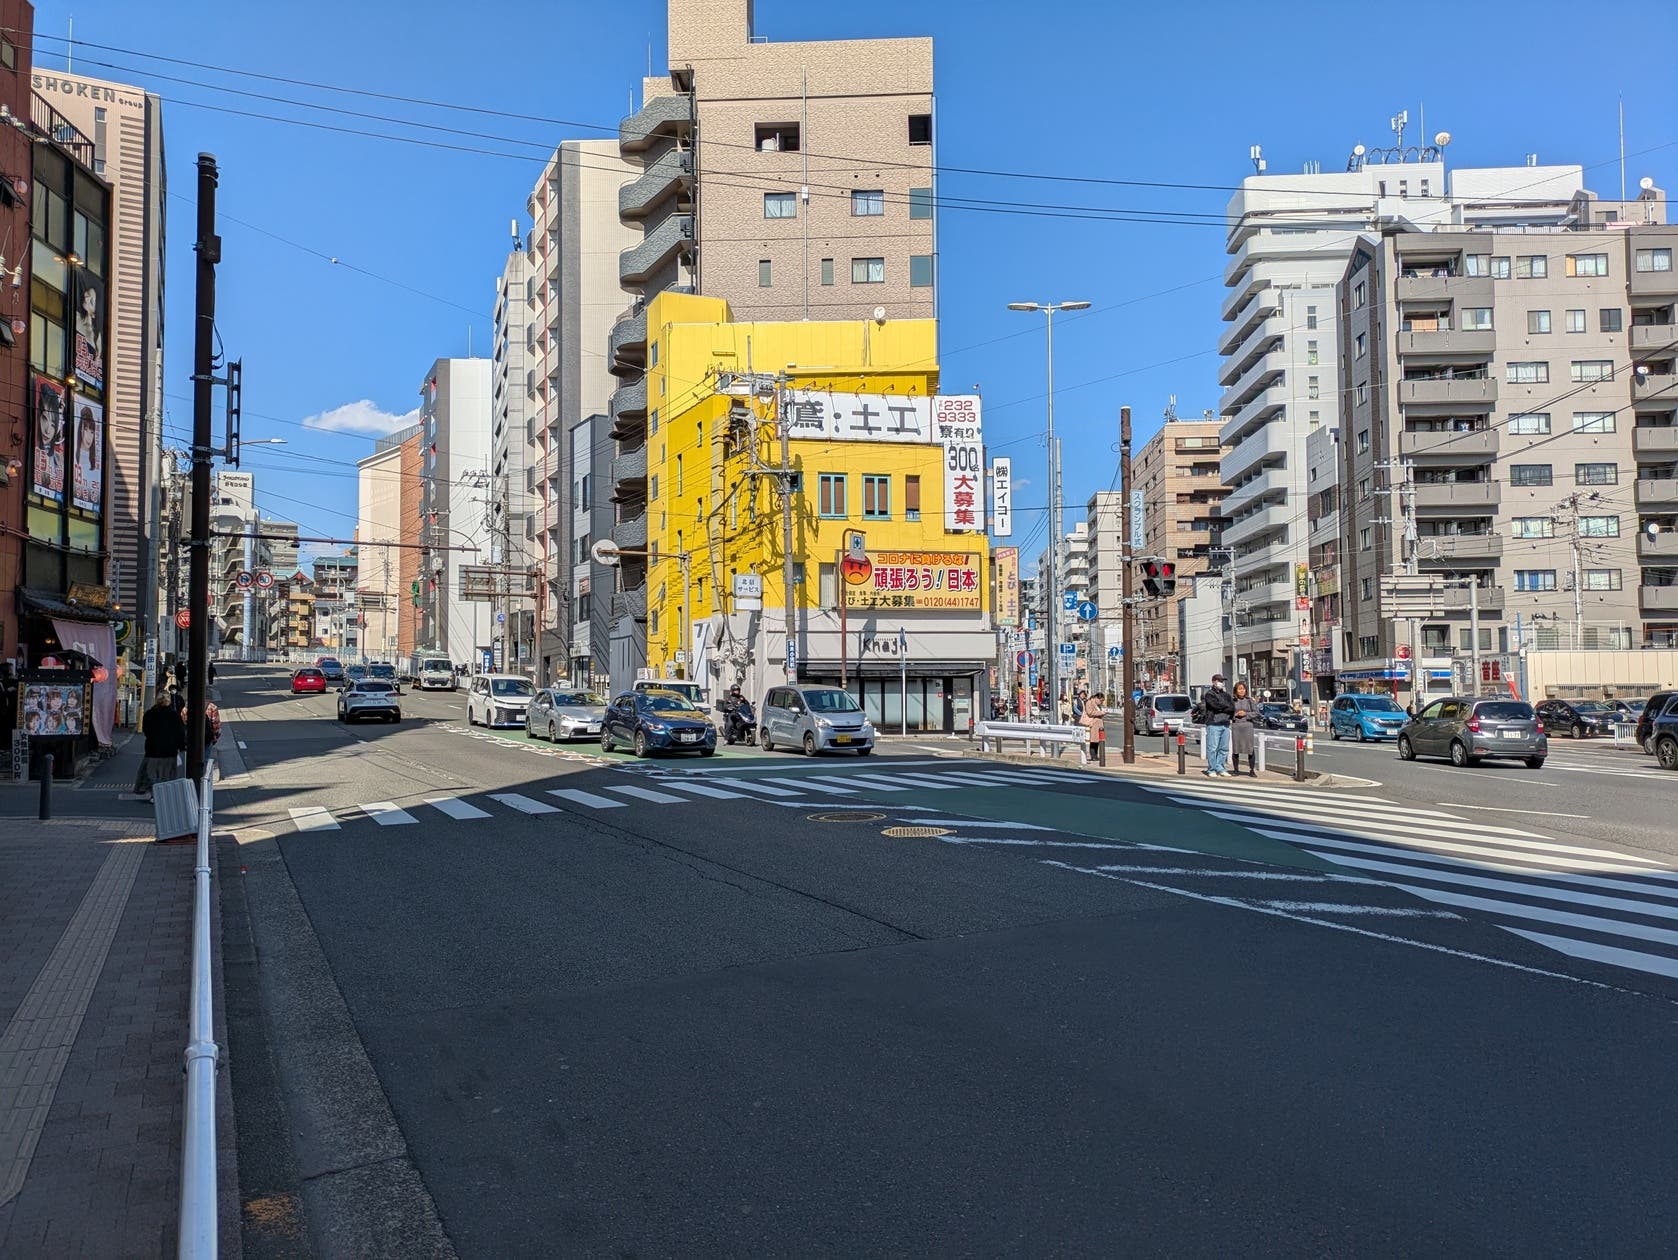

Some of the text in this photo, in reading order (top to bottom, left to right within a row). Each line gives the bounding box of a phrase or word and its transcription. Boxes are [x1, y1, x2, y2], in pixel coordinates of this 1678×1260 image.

[32, 74, 115, 103] SHOKEN
[944, 400, 973, 411] 232
[791, 400, 921, 434] 鳶・土工
[938, 412, 976, 422] 9333
[939, 425, 975, 439] 寮有り
[953, 474, 976, 525] 大募集
[843, 594, 979, 607] び・土工大募集 0120(44)1747
